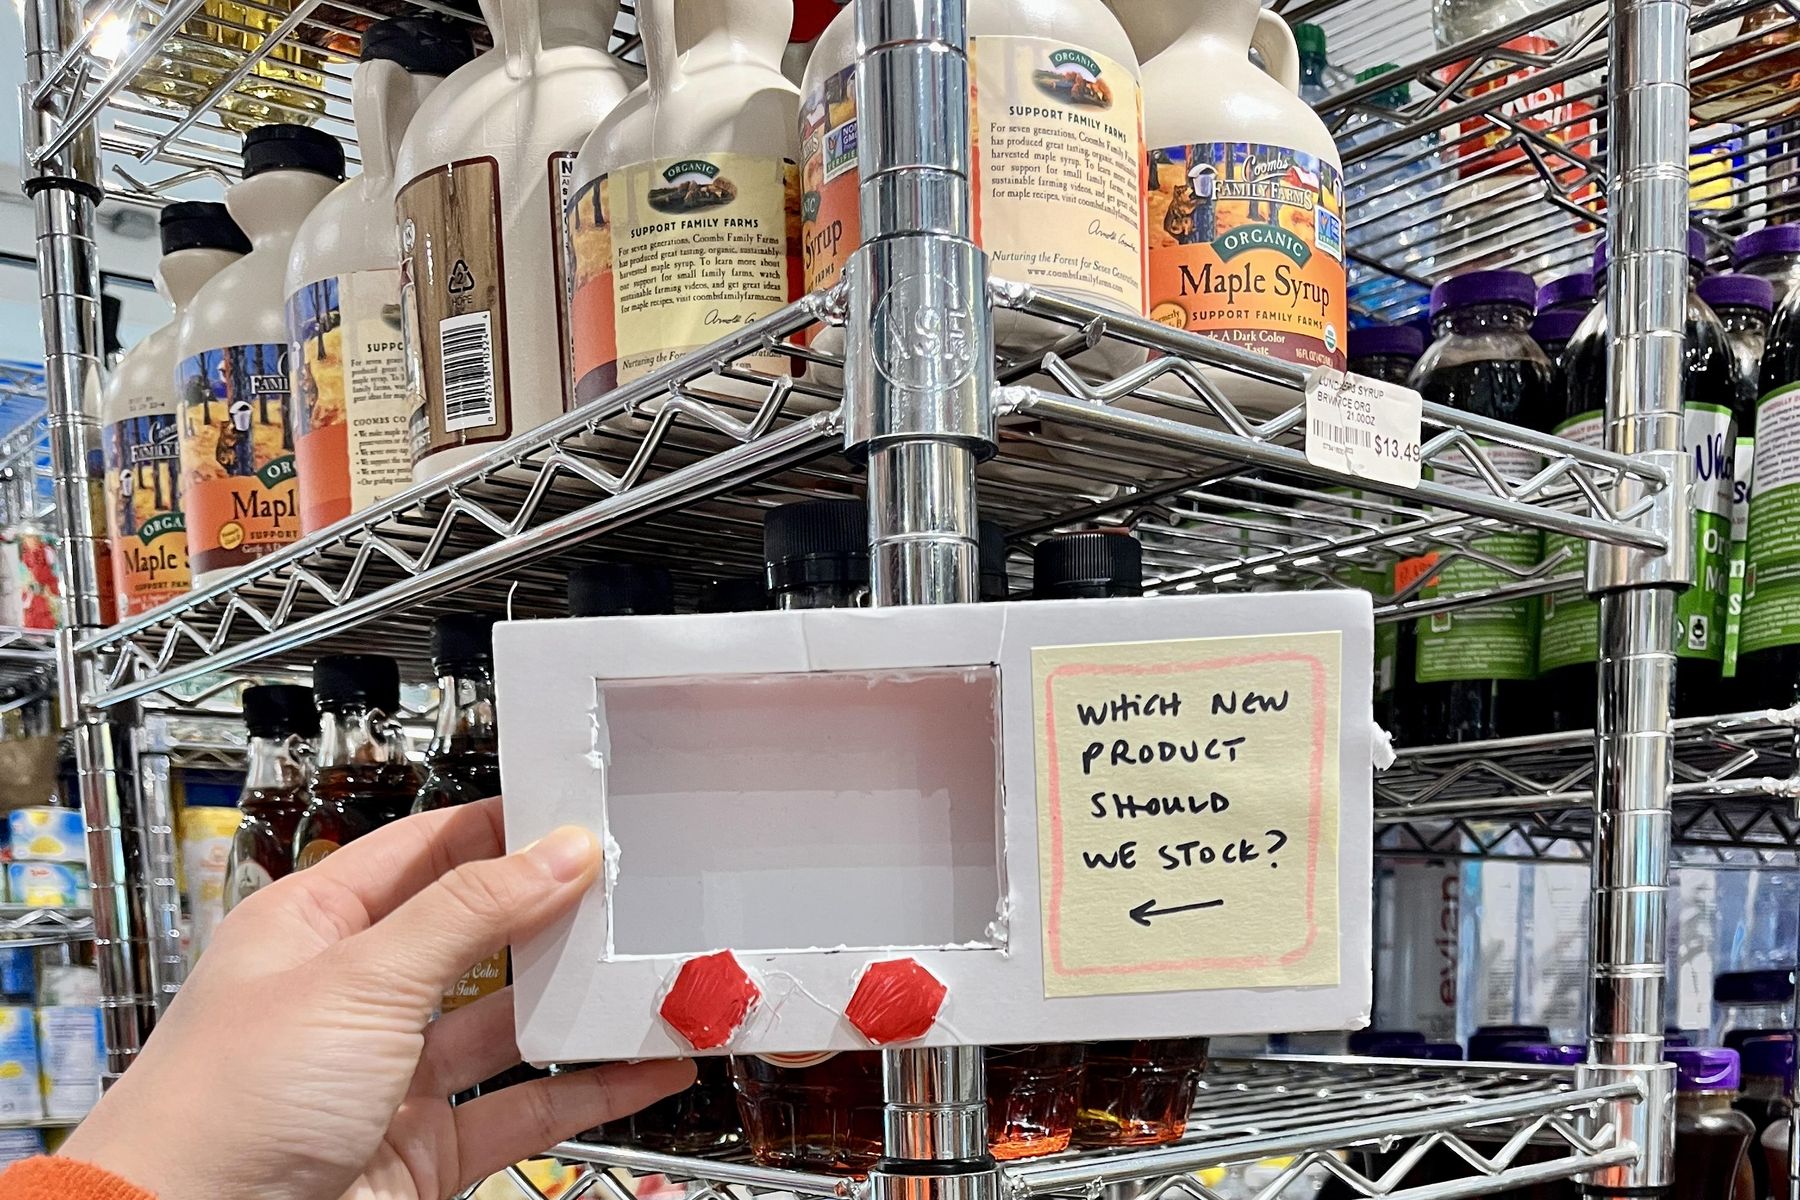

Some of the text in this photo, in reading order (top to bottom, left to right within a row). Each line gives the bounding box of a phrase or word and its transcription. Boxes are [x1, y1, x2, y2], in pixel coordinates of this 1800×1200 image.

[1055, 52, 1096, 72] ORGANIC
[1009, 106, 1127, 143] SUPPORT FAMILY FARMS
[991, 123, 1005, 132] For
[1009, 125, 1030, 133] seven
[1034, 127, 1076, 140] generations,
[1079, 132, 1105, 148] Coombs
[991, 136, 1004, 145] has
[1007, 138, 1043, 147] produced
[1046, 141, 1064, 149] great
[668, 161, 713, 177] ORGANIC
[992, 149, 1029, 159] harvested
[1034, 152, 1056, 162] maple
[1060, 156, 1081, 167] syrup.
[1085, 159, 1094, 169] To
[1242, 152, 1290, 181] Coombs
[1011, 165, 1041, 175] support
[1046, 164, 1058, 174] for
[1063, 167, 1082, 179] small
[1087, 172, 1106, 186] family
[992, 175, 1035, 185] sustainable
[1038, 176, 1068, 191] farming
[1071, 182, 1093, 195] videos,
[1095, 191, 1105, 199] and
[992, 188, 1077, 204] for maple recipes, visit
[1211, 180, 1314, 211] FAMILY FARMS
[630, 218, 759, 238] SUPPORT FAMILY FARMS
[618, 247, 629, 257] For
[650, 238, 690, 250] generations,
[693, 233, 724, 243] Coombs
[727, 233, 753, 244] Family
[757, 234, 779, 245] Farms
[804, 219, 843, 276] Syrup
[1224, 229, 1303, 257] ORGANIC
[619, 267, 647, 279] harvested
[651, 262, 670, 273] maple
[674, 260, 695, 270] syrup.
[700, 257, 710, 266] To
[715, 257, 733, 265] learn
[761, 259, 780, 267] about
[630, 253, 658, 267] produced
[661, 251, 677, 260] great
[708, 248, 738, 256] organic,
[992, 251, 1036, 264] Nurturing
[1039, 251, 1051, 262] the
[1053, 253, 1078, 266] Forest
[1080, 257, 1092, 270] for
[634, 277, 657, 288] support
[661, 273, 672, 282] for
[677, 270, 696, 279] small
[701, 269, 726, 278] family
[731, 269, 754, 278] farms,
[655, 284, 682, 294] farming
[685, 282, 709, 291] videos,
[728, 282, 739, 291] get
[763, 283, 781, 291] ideas
[1179, 263, 1329, 316] Maple Syrup
[621, 294, 691, 314] for maple recipes, visit
[1192, 310, 1323, 330] SUPPORT FAMILY FARMS
[1222, 332, 1230, 341] A
[1233, 331, 1256, 342] Dark
[1260, 332, 1285, 344] Color
[622, 358, 655, 370] Nurturing
[656, 352, 667, 363] the
[1358, 386, 1384, 399] SYRUP
[1355, 400, 1370, 413] ORG
[1375, 435, 1420, 462] $13.49
[232, 489, 297, 527] Mapl
[251, 530, 298, 539] SUPPORT
[123, 546, 178, 579] Maple
[1212, 690, 1289, 716] NEW
[1082, 737, 1246, 774] PRODUCT
[1091, 792, 1230, 819] SHOULD
[1083, 830, 1288, 871] WE STOCK?
[1435, 876, 1459, 1007] evian
[473, 963, 499, 979] Color
[456, 980, 480, 996] Taste
